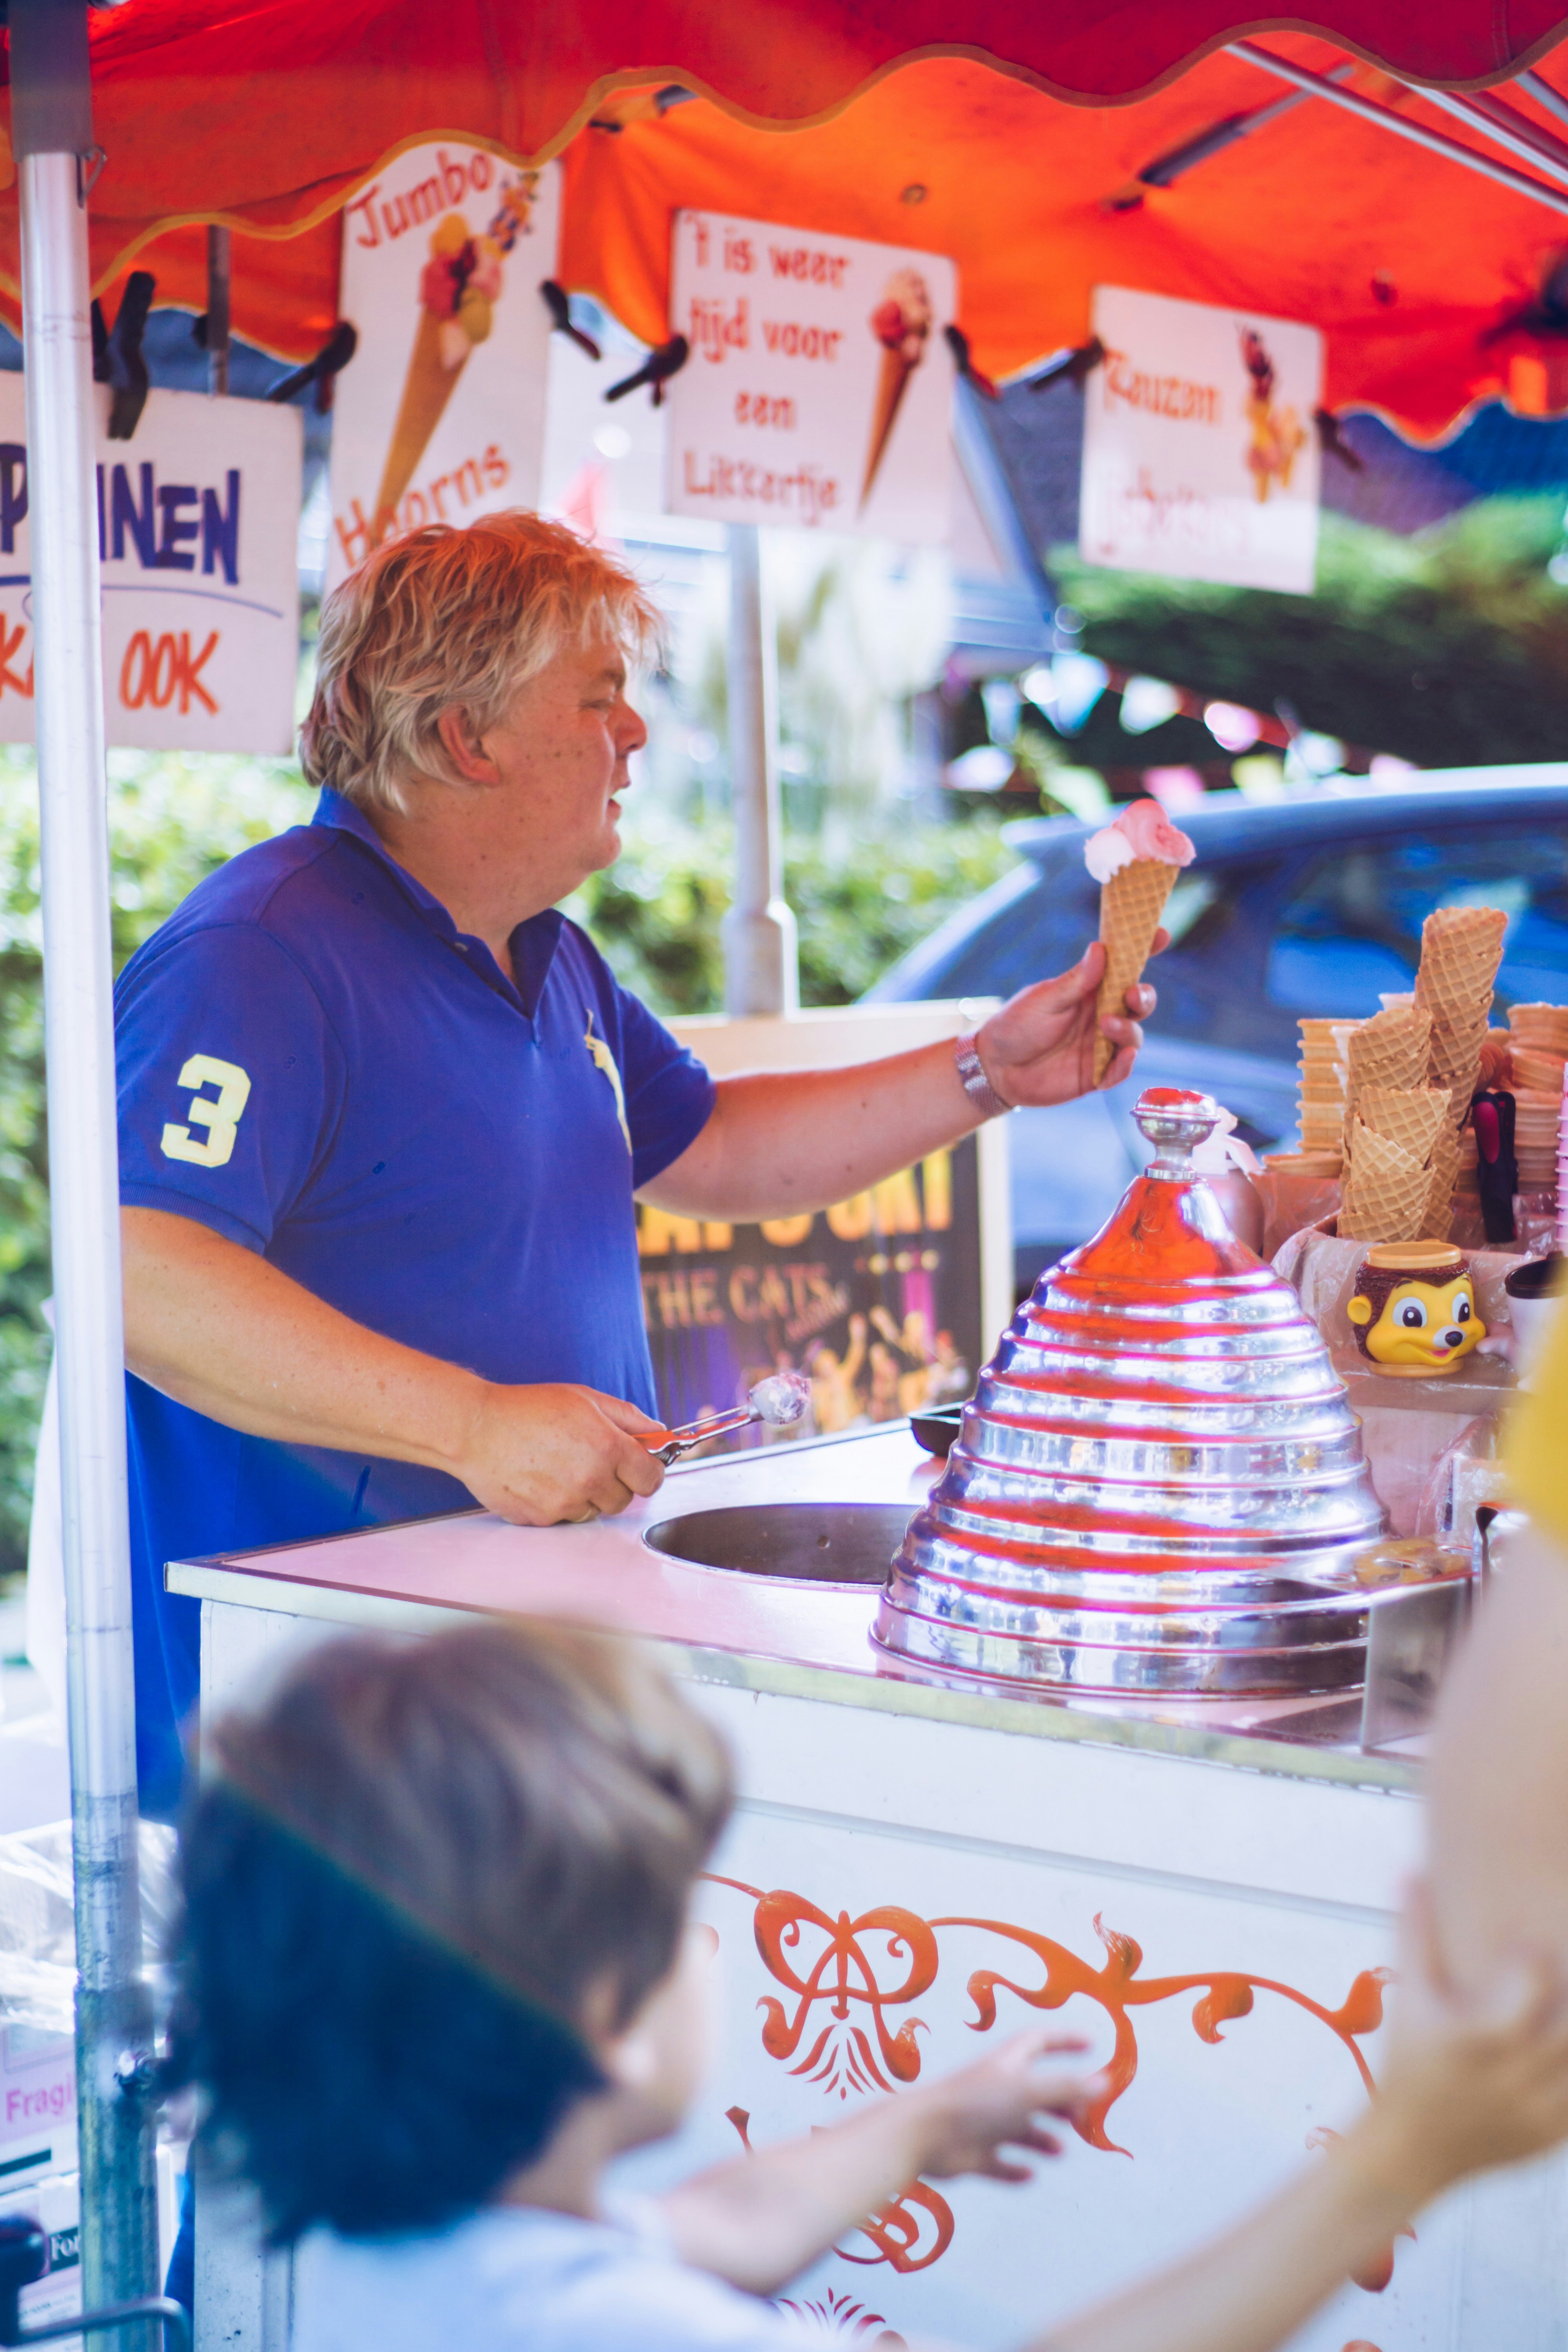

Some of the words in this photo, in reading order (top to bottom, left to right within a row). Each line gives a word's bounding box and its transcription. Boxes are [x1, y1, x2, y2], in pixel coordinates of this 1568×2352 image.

[346, 149, 495, 249] Jumbo
[724, 225, 755, 274] is
[768, 245, 849, 289] weer
[691, 296, 750, 363] tijd
[762, 320, 843, 363] voor
[734, 390, 797, 431] een
[0, 443, 240, 585] PNEN
[119, 630, 220, 714] OOK
[160, 1053, 252, 1168] 3
